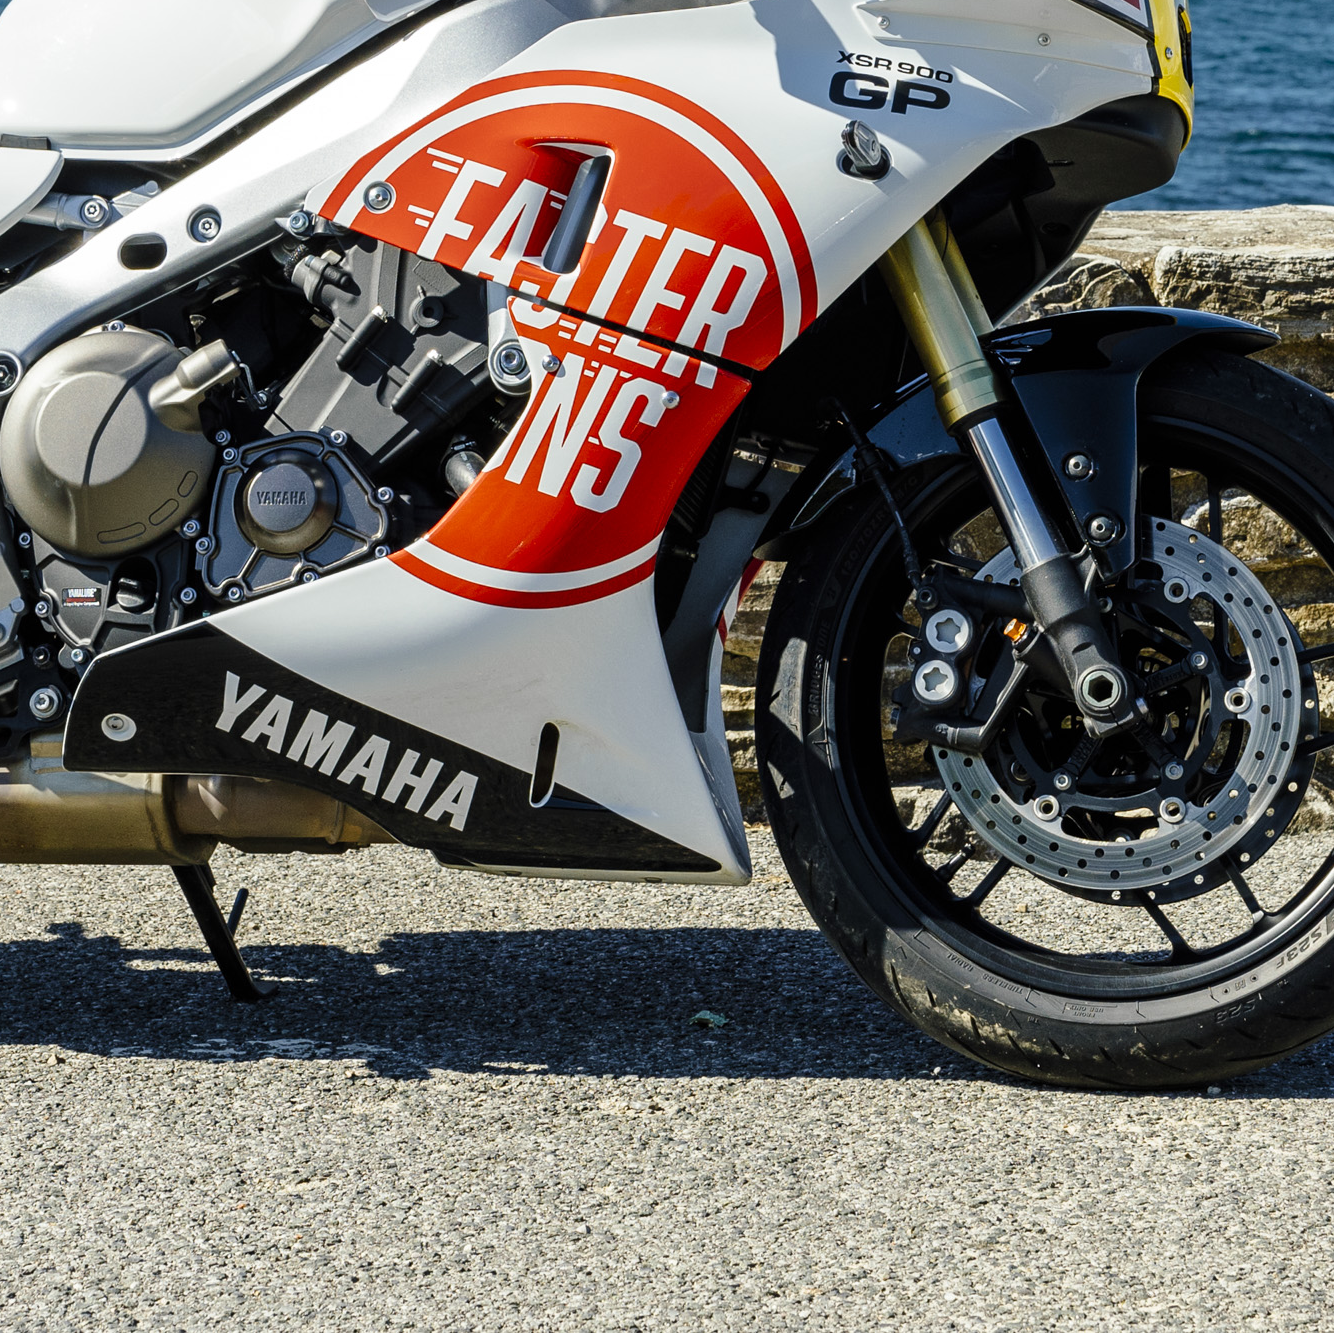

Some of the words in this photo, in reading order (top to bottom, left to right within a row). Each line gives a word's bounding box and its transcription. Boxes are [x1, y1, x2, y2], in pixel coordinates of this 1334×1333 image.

[836, 50, 893, 71] XSR
[897, 62, 954, 84] 900
[829, 70, 951, 115] GP
[256, 491, 307, 506] YAMAHA
[808, 618, 830, 715] BRIDGESTONE
[215, 670, 479, 832] YAMAHA
[1275, 926, 1322, 969] S23F
